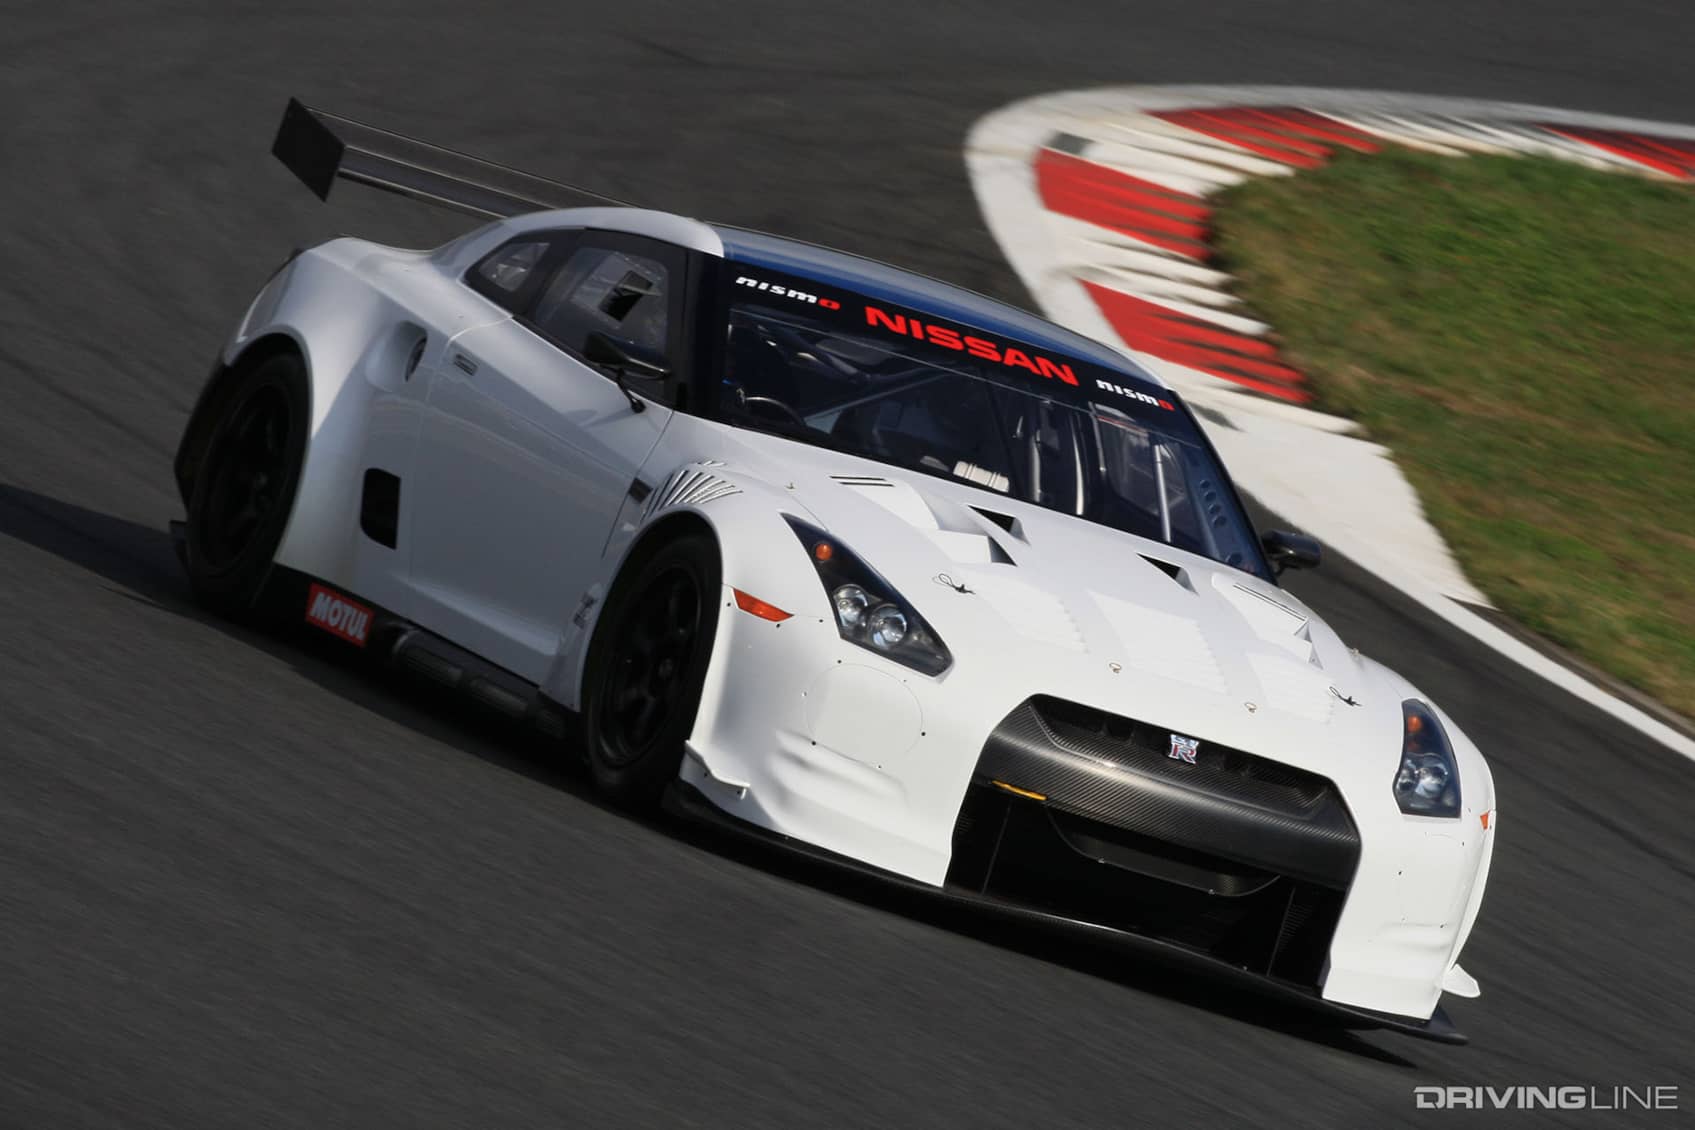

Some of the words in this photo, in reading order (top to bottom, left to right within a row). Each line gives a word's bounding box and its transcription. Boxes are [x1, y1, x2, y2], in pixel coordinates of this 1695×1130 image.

[735, 276, 841, 310] nismo
[864, 305, 1080, 387] NISSAN
[1095, 379, 1175, 411] nismo
[310, 592, 368, 641] MOTUL
